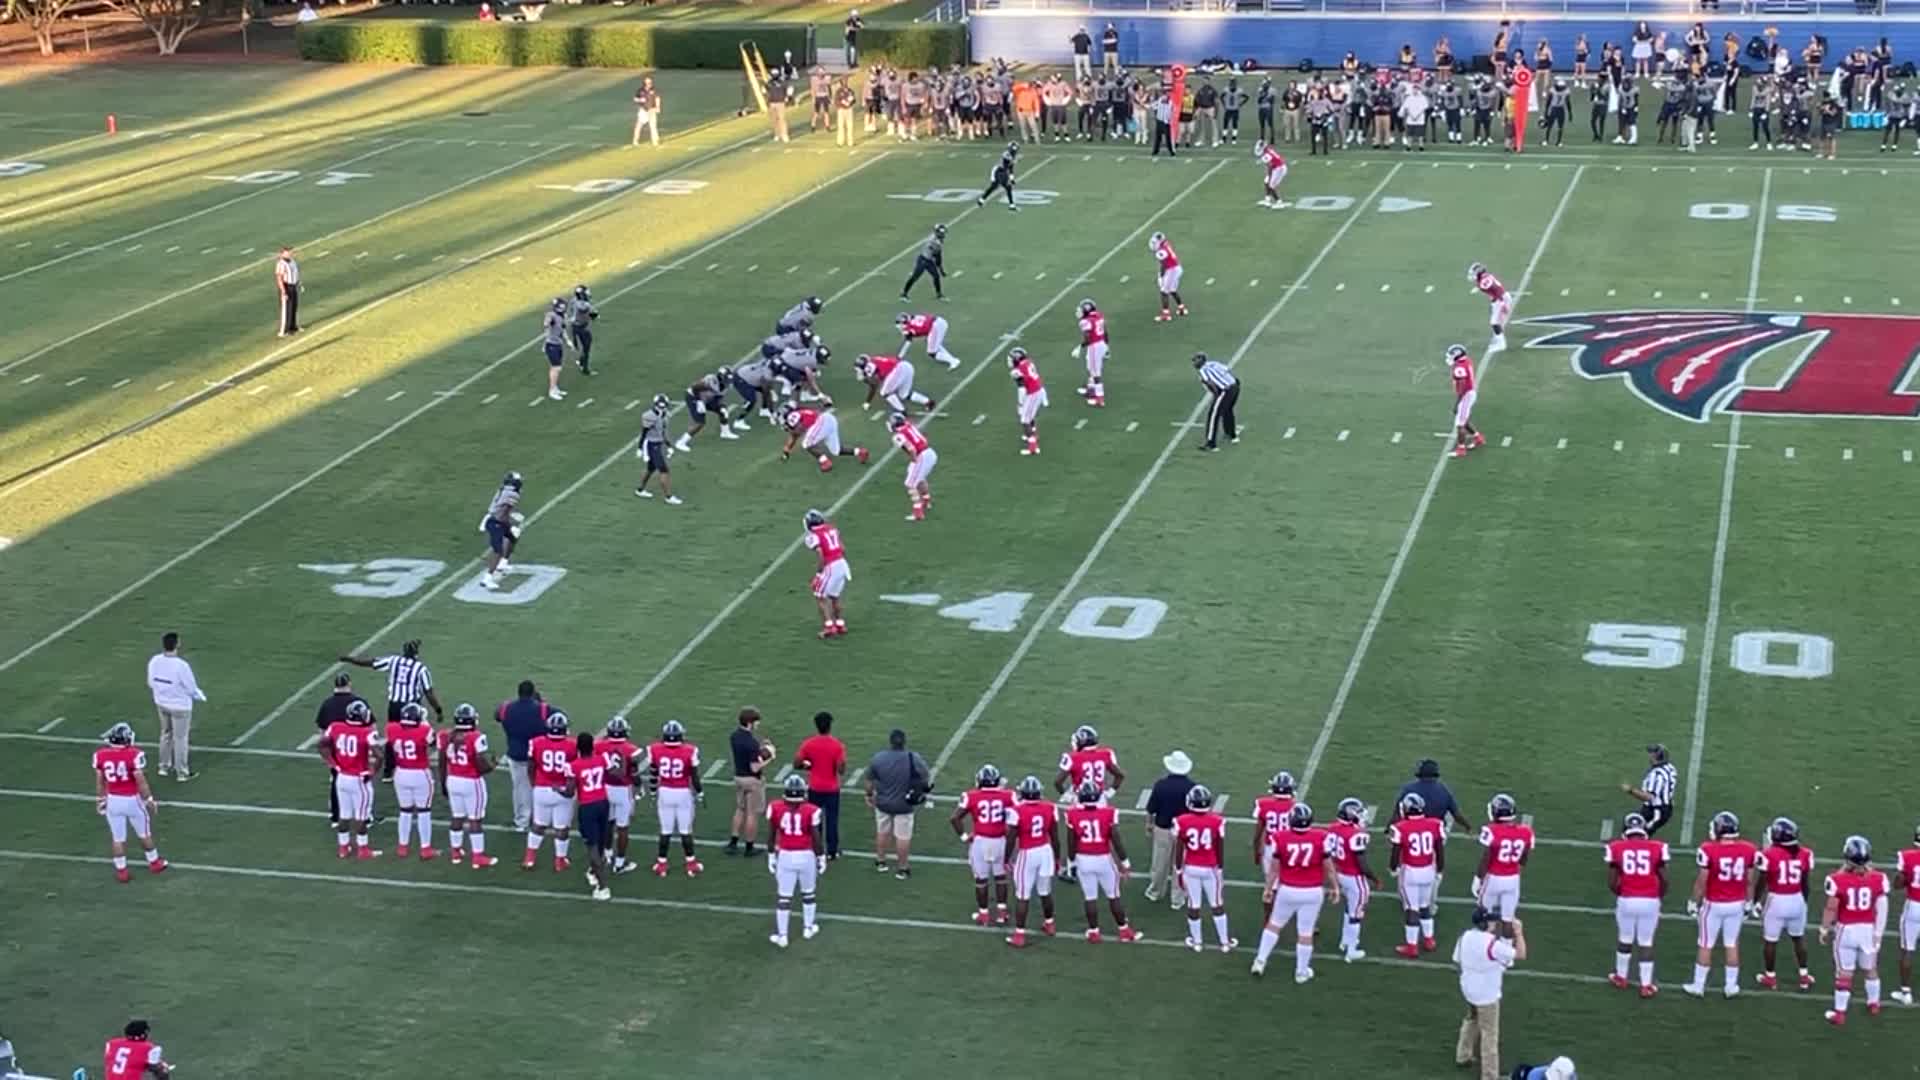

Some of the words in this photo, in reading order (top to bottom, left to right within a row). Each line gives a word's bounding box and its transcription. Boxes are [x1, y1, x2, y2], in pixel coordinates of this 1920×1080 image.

[823, 530, 842, 547] 17
[936, 591, 1168, 640] 40
[1582, 622, 1834, 679] 50
[335, 734, 358, 757] 40
[393, 739, 415, 760] 42
[446, 743, 469, 765] 45
[103, 760, 128, 782] 24
[543, 750, 567, 771] 99
[658, 757, 685, 778] 22
[1081, 761, 1105, 782] 33
[581, 768, 604, 792] 37
[977, 800, 1004, 822] 32
[1265, 812, 1289, 832] 28
[779, 813, 803, 835] 41
[1031, 816, 1043, 837] 2
[1079, 820, 1103, 843] 31
[1186, 828, 1212, 850] 34
[1408, 831, 1434, 856] 30
[1286, 843, 1314, 866] 77
[1498, 840, 1524, 862] 23
[1622, 850, 1650, 875] 65
[1719, 858, 1744, 881] 54
[1778, 861, 1802, 884] 15
[1846, 887, 1872, 911] 18
[110, 1046, 130, 1074] 5
